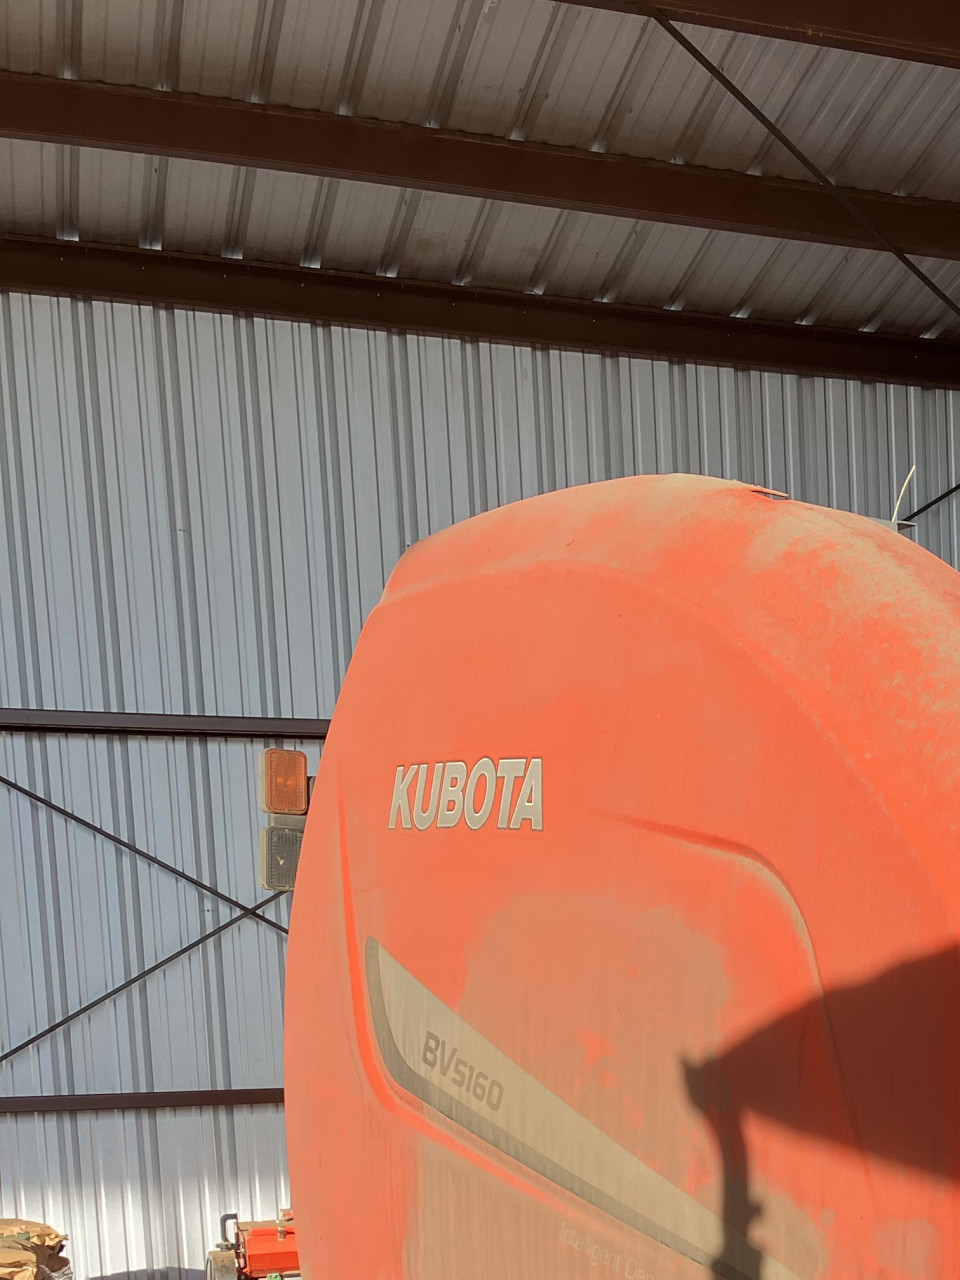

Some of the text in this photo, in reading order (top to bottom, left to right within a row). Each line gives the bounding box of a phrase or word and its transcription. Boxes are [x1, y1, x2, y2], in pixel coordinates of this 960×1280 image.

[388, 757, 544, 831] KUBOTA
[421, 1030, 505, 1112] BV5160
[560, 1221, 622, 1273] Intelligent
